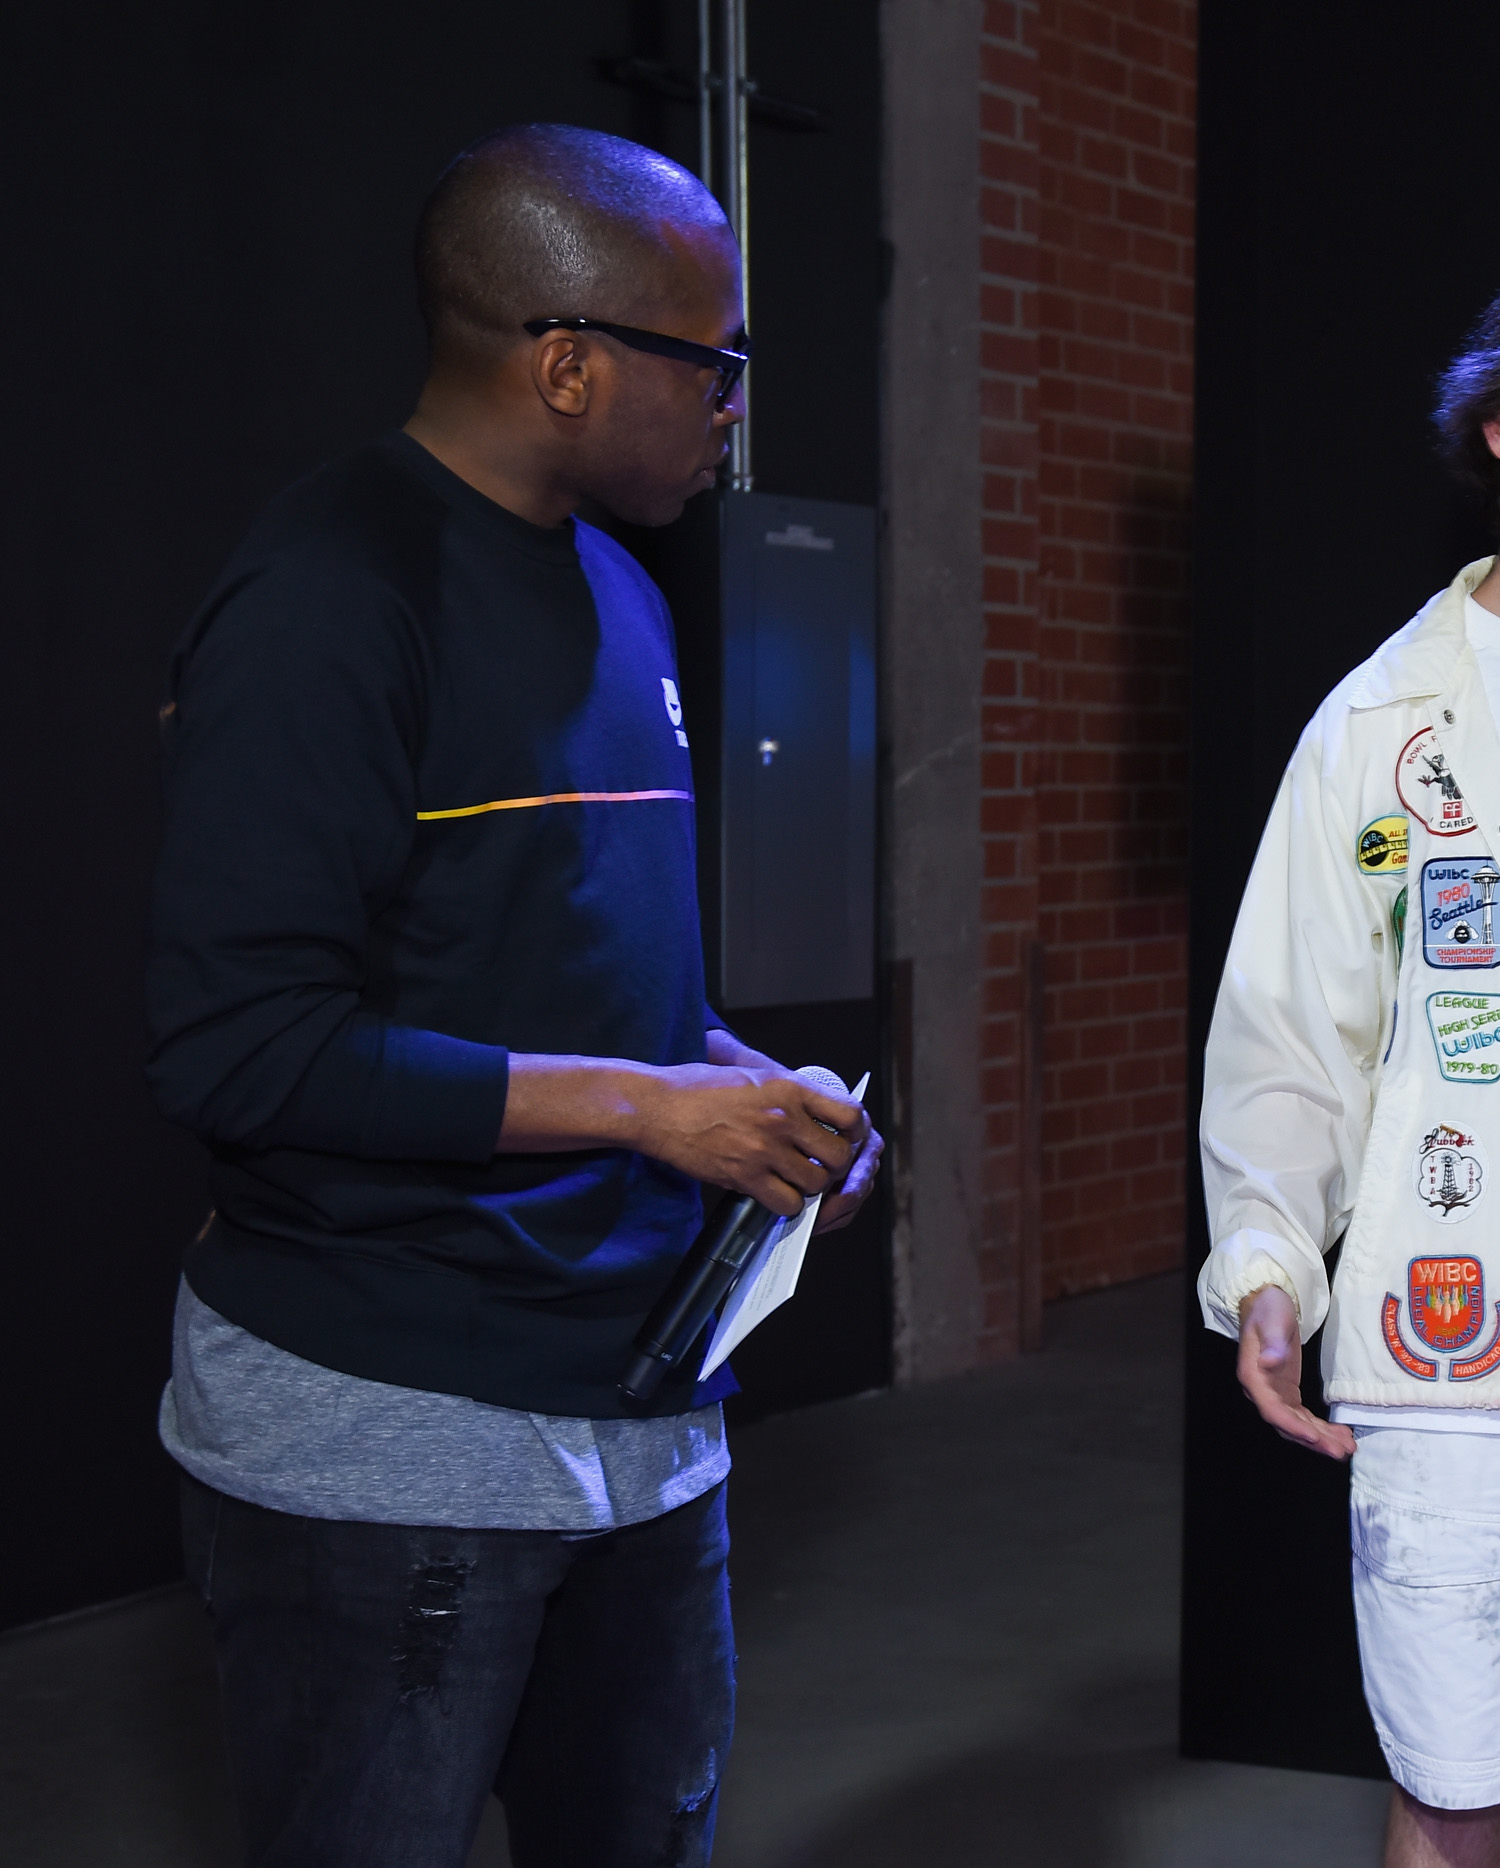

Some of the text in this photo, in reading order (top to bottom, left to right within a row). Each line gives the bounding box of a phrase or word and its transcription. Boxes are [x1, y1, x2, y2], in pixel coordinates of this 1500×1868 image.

[1406, 741, 1428, 765] BOWL
[1439, 817, 1474, 829] CARED
[1362, 832, 1384, 848] WIBC
[1388, 829, 1403, 838] ALL
[1391, 852, 1408, 864] Gam
[1437, 882, 1470, 907] 1980
[1429, 895, 1498, 930] Seattle
[1436, 948, 1496, 956] CHAMPIONSHIP
[1439, 956, 1494, 964] TOURNAMENT
[1435, 996, 1490, 1009] LEAGUE
[1446, 1061, 1499, 1075] 1979-80
[1416, 1262, 1477, 1282] WIBC
[1385, 1304, 1396, 1336] CLASS
[1414, 1285, 1480, 1346] LOCAL CHAMPION
